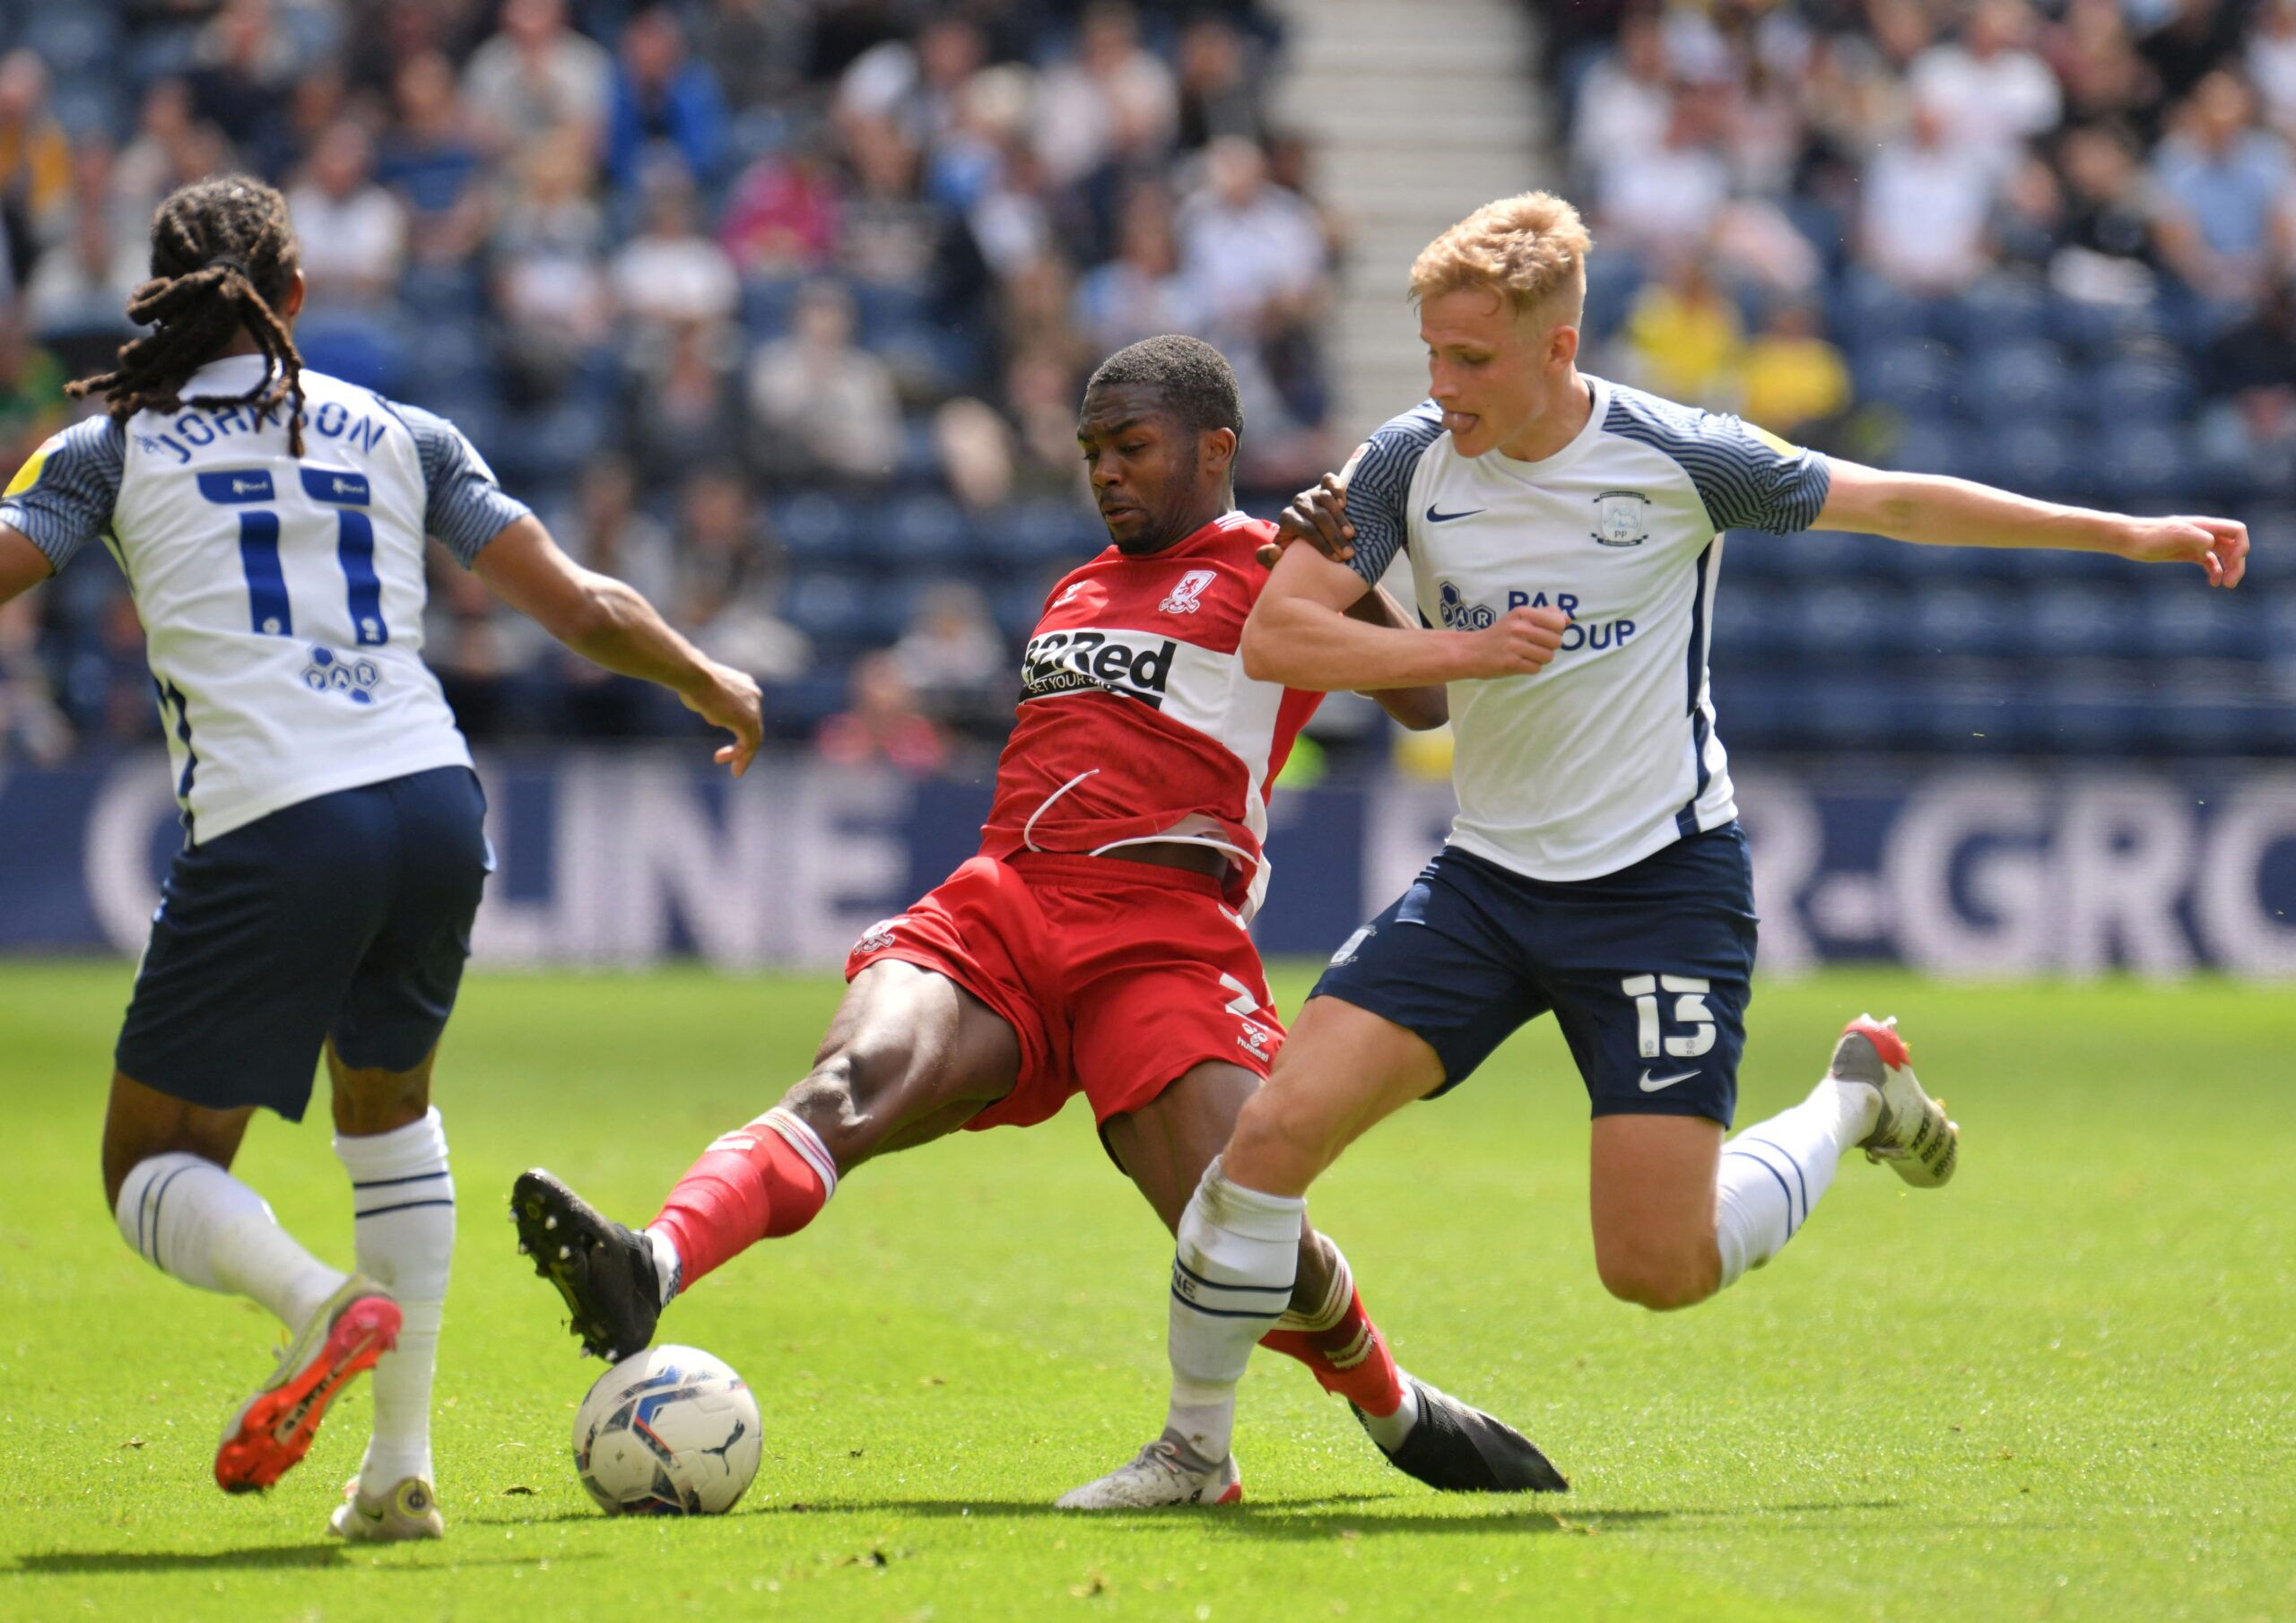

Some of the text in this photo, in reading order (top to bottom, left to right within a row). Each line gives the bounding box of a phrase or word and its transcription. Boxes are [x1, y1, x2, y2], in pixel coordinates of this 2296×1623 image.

[1561, 619, 1637, 652] OUP
[1028, 678, 1048, 694] SET
[1048, 673, 1086, 690] YOUR
[1622, 973, 1718, 1058] 13
[1237, 1036, 1270, 1063] hummel
[1171, 1263, 1196, 1300] NE
